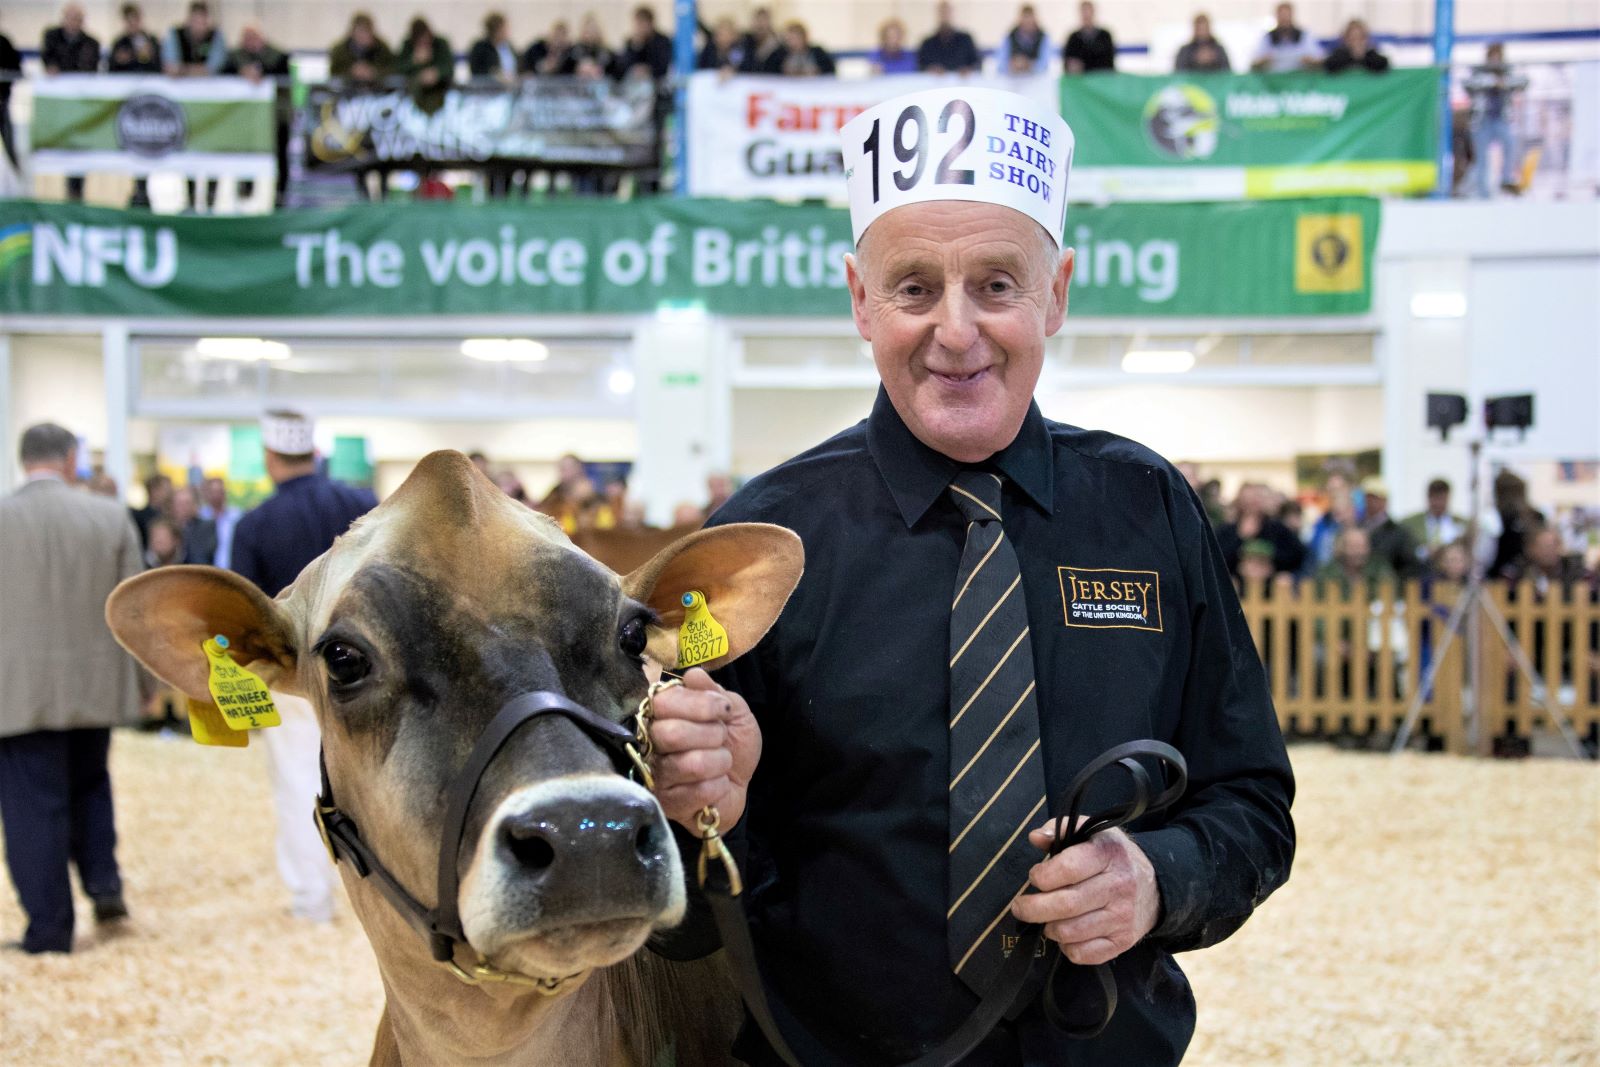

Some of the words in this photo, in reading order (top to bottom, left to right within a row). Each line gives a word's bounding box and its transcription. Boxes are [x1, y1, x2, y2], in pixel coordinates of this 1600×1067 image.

[863, 99, 976, 204] 192
[1004, 112, 1051, 148] THE
[744, 138, 845, 177] Gua
[986, 135, 1057, 180] DAIRY
[988, 161, 1052, 205] SHOW
[32, 222, 179, 288] NFU
[282, 227, 405, 288] The
[419, 224, 588, 286] voice
[602, 221, 678, 286] of
[692, 225, 852, 288] Britis
[1068, 571, 1151, 617] JERSEY
[1072, 602, 1103, 611] CATTLE
[1105, 603, 1141, 612] SOCIETY
[1072, 610, 1081, 618] OF
[1082, 611, 1093, 619] THE
[1093, 611, 1115, 619] UNITED
[1116, 611, 1144, 621] KINGDOM
[683, 629, 713, 647] 745534
